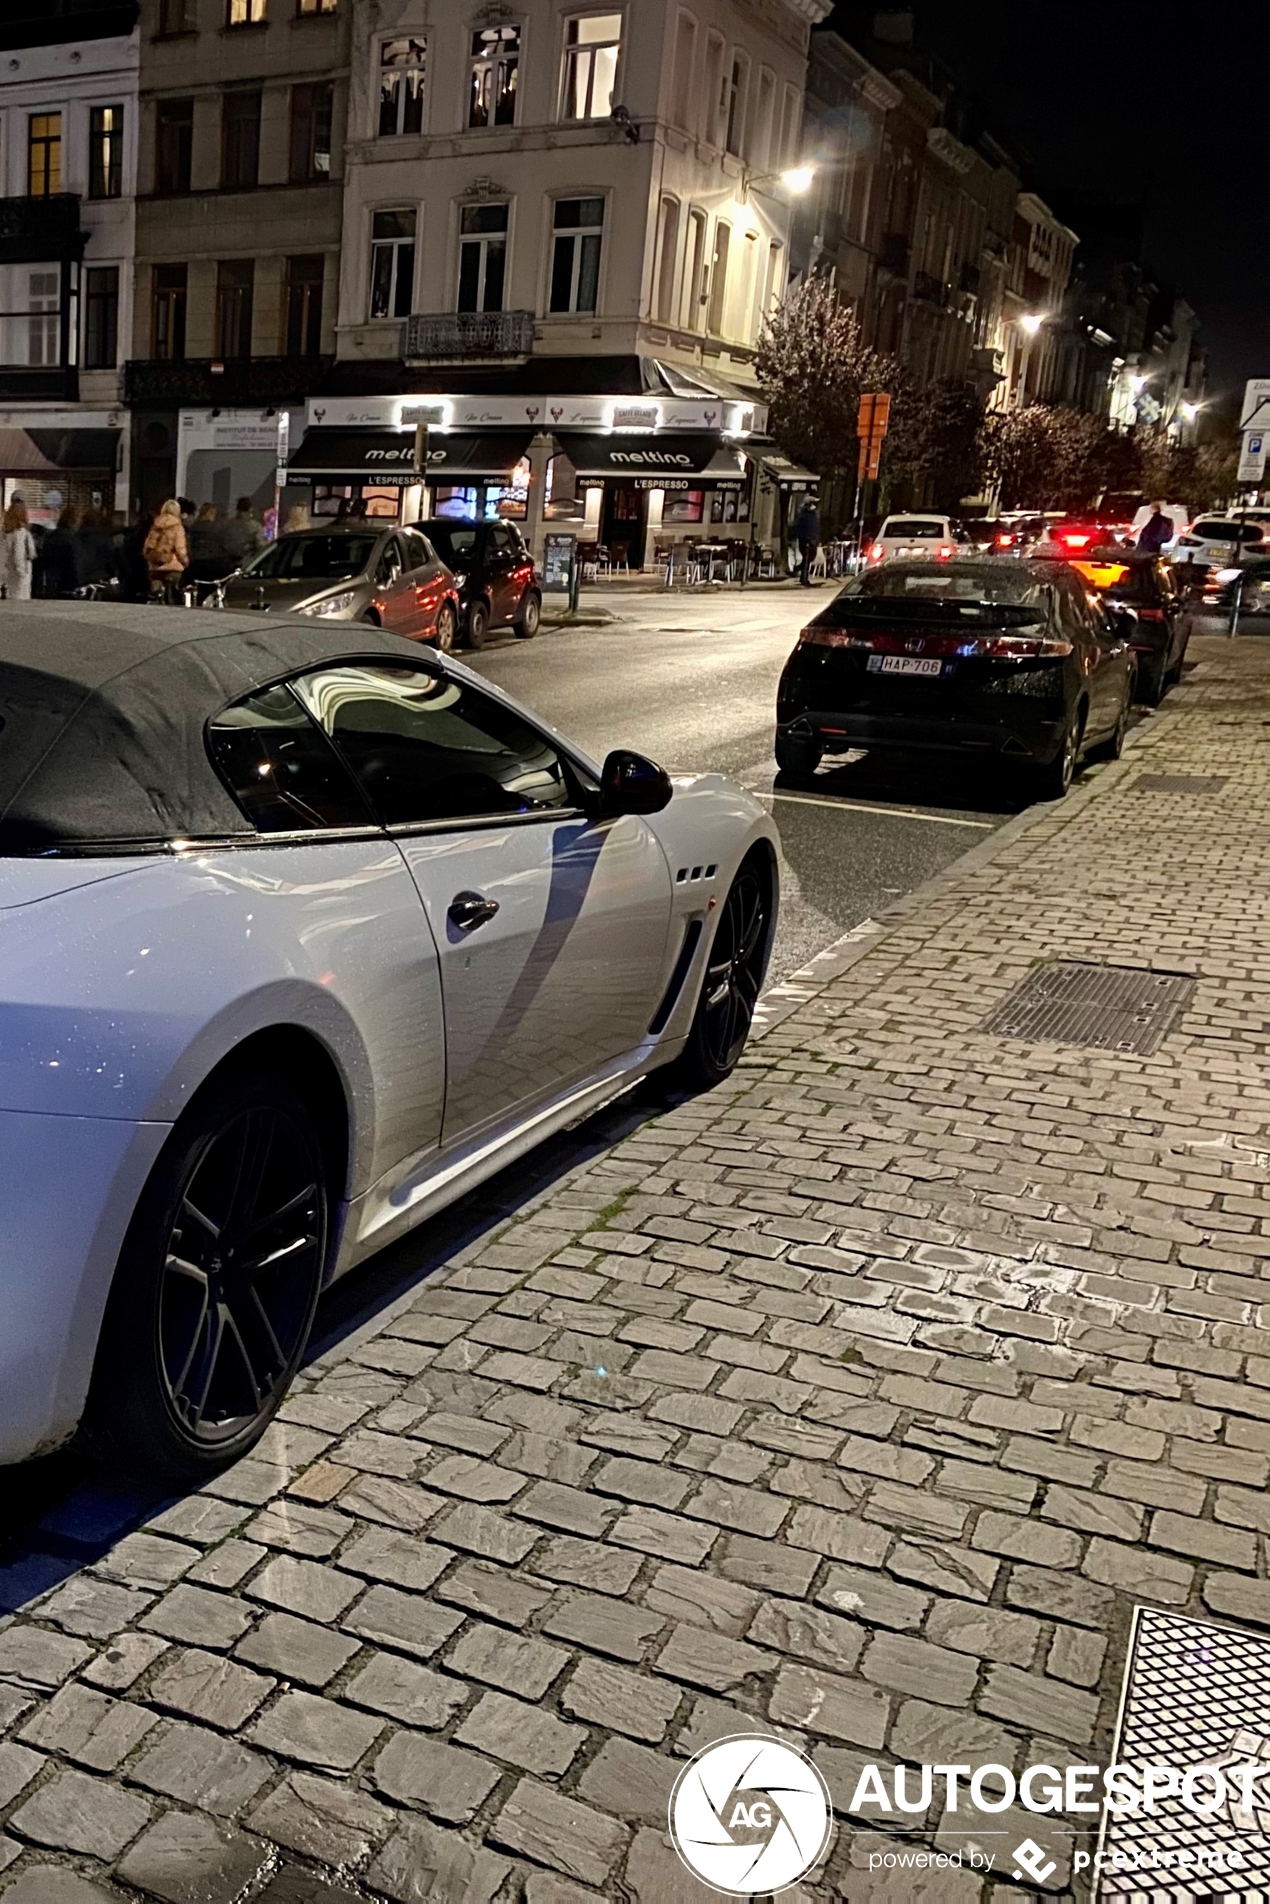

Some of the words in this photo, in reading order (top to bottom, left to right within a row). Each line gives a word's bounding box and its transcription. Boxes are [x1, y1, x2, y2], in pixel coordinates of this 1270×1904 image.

[1250, 440, 1260, 452] P
[364, 447, 447, 460] melto
[610, 450, 690, 464] meltino
[368, 476, 422, 485] L'ESPRESSO
[634, 479, 688, 489] L'ESPRESSO
